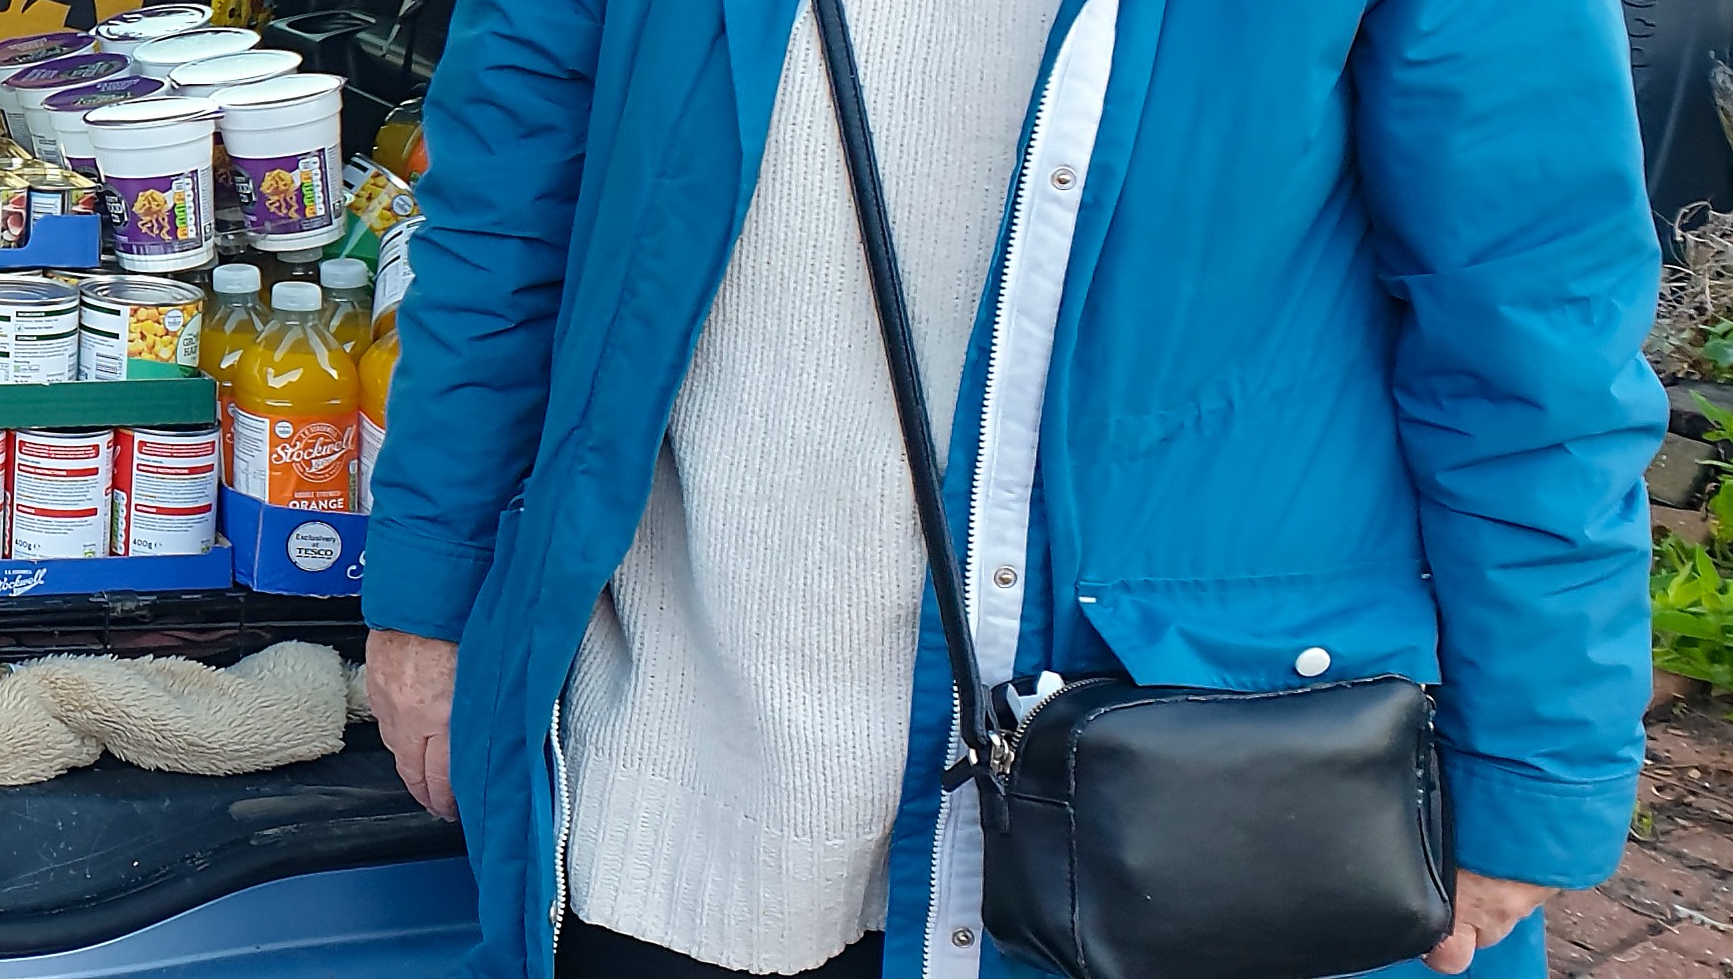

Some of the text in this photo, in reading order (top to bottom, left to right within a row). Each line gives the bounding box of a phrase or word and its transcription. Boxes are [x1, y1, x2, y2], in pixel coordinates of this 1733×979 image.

[271, 424, 357, 465] Stockwell
[289, 498, 345, 510] ORANGE
[133, 538, 153, 549] 400g
[295, 533, 337, 543] Exclusively
[15, 539, 32, 551] 400g
[296, 547, 333, 557] TESCO
